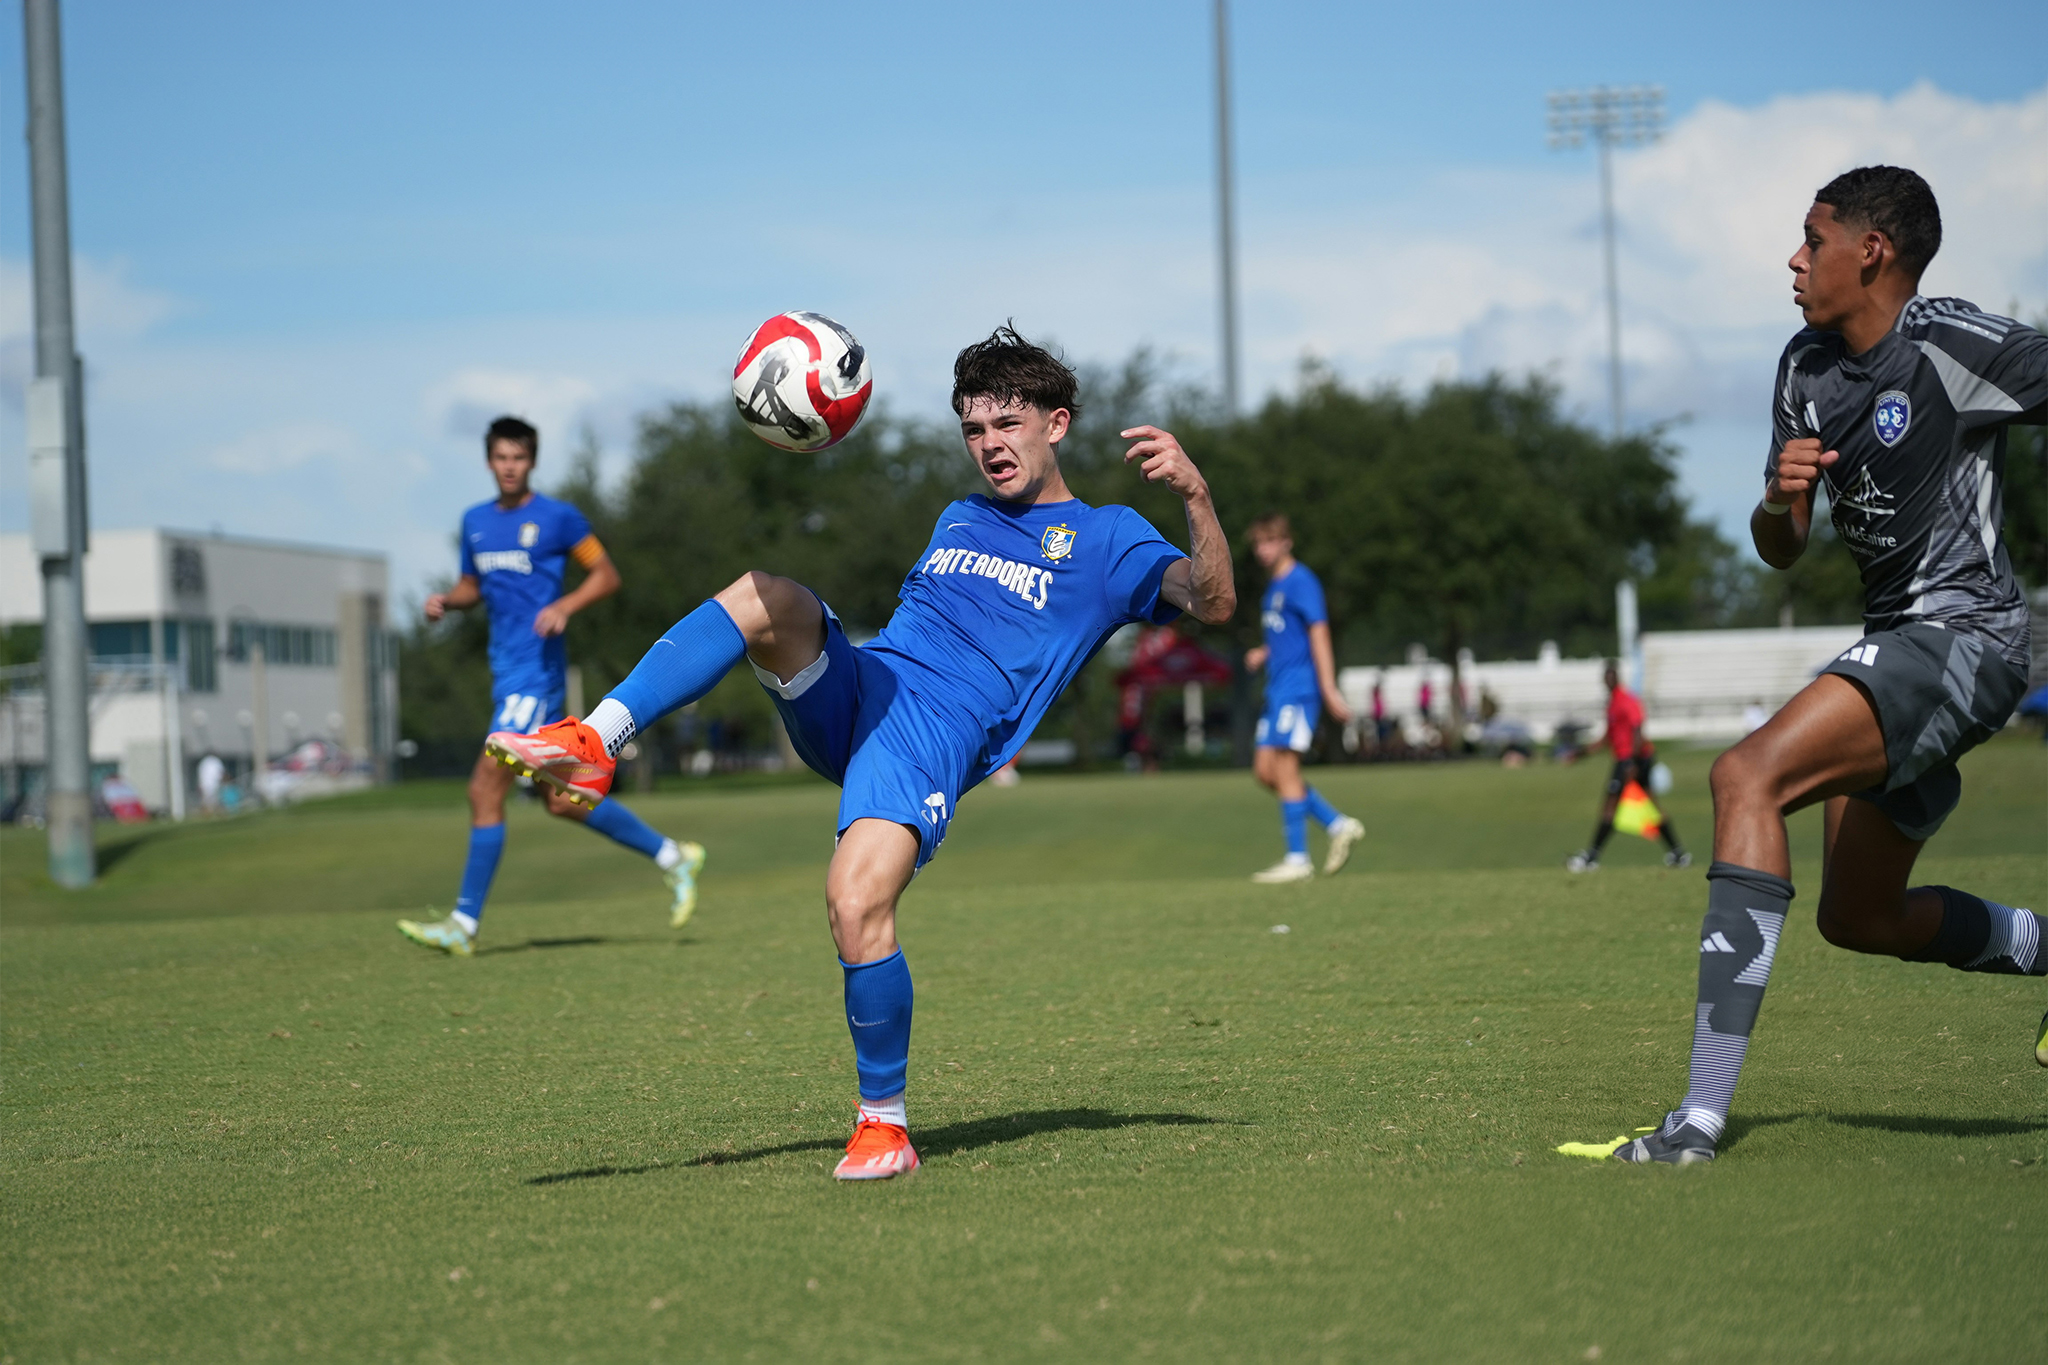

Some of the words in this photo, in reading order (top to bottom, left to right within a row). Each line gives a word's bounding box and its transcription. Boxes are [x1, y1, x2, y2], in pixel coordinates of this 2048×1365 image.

[1879, 396, 1906, 407] UNITED
[1843, 521, 1898, 548] McEntire
[922, 548, 1053, 610] PATEADORES
